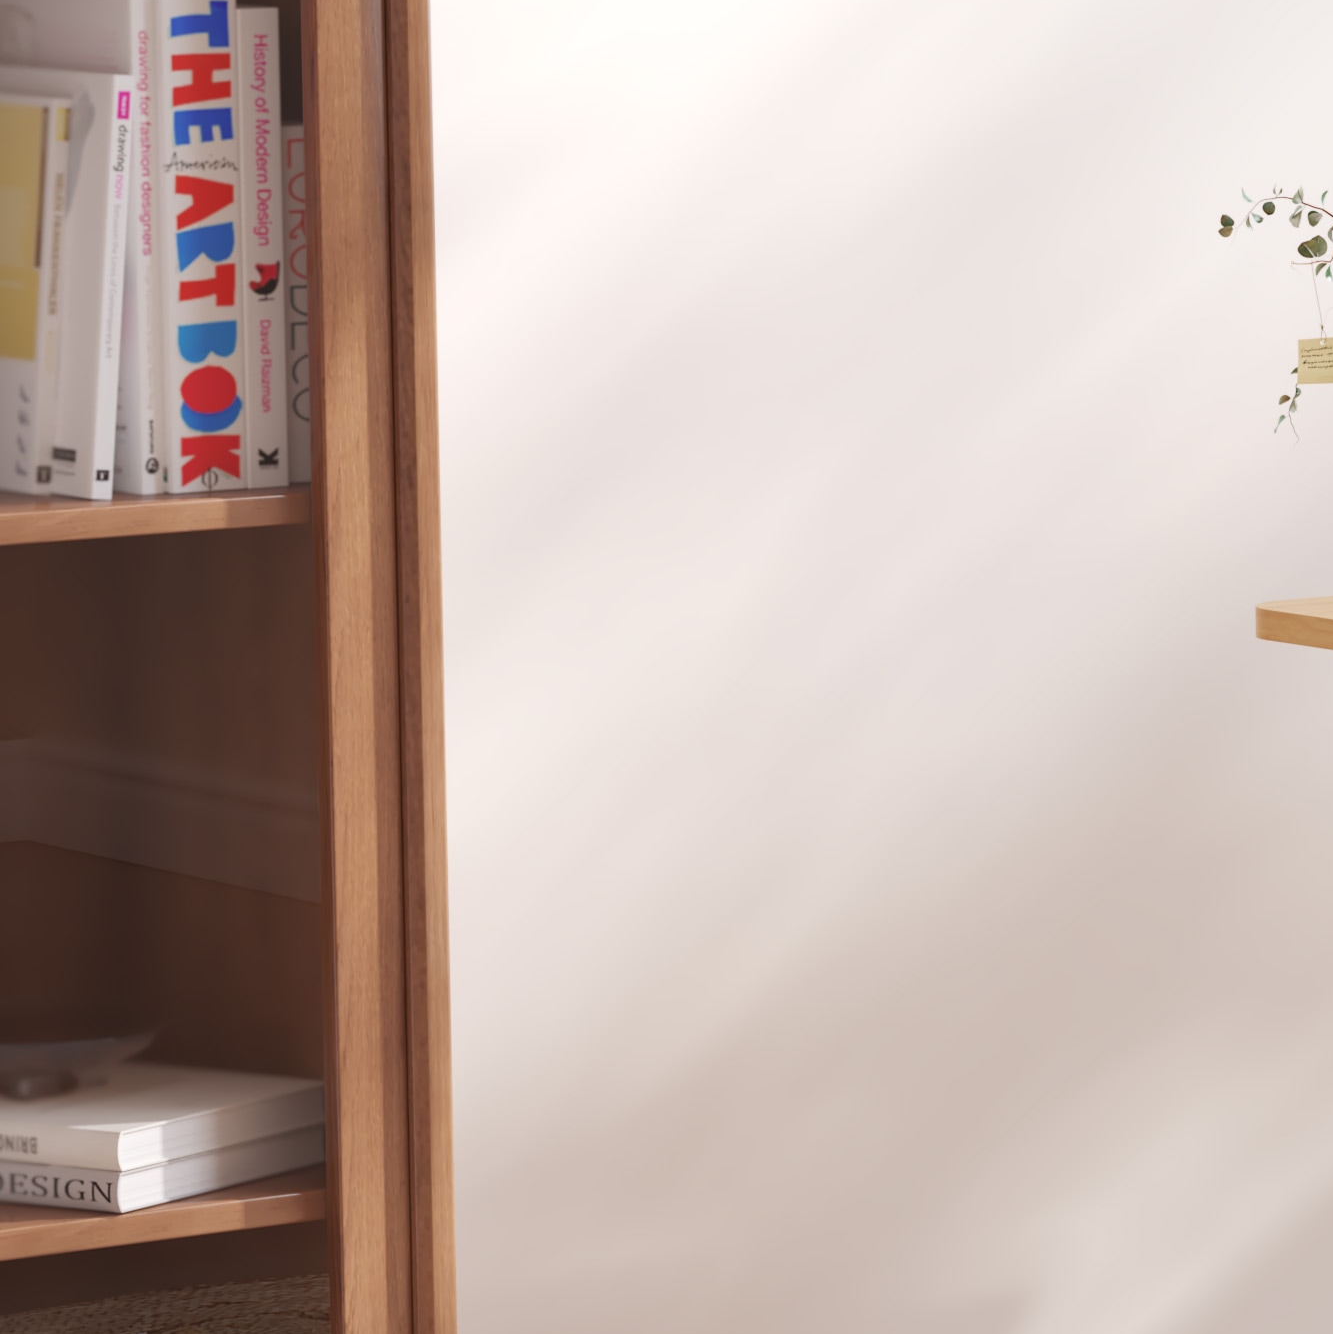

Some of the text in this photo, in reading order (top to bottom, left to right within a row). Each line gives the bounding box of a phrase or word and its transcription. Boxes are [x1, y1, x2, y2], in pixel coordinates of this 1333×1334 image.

[136, 30, 150, 91] drawing
[170, 0, 234, 147] THE
[139, 96, 151, 117] for
[113, 124, 128, 172] drawing
[139, 120, 152, 177] fashion
[251, 33, 272, 246] History of Modern Design
[114, 173, 124, 200] now
[138, 181, 153, 256] designers
[176, 174, 236, 307] ART
[259, 319, 273, 413] David Raizman
[0, 1172, 112, 1203] ESIGN
